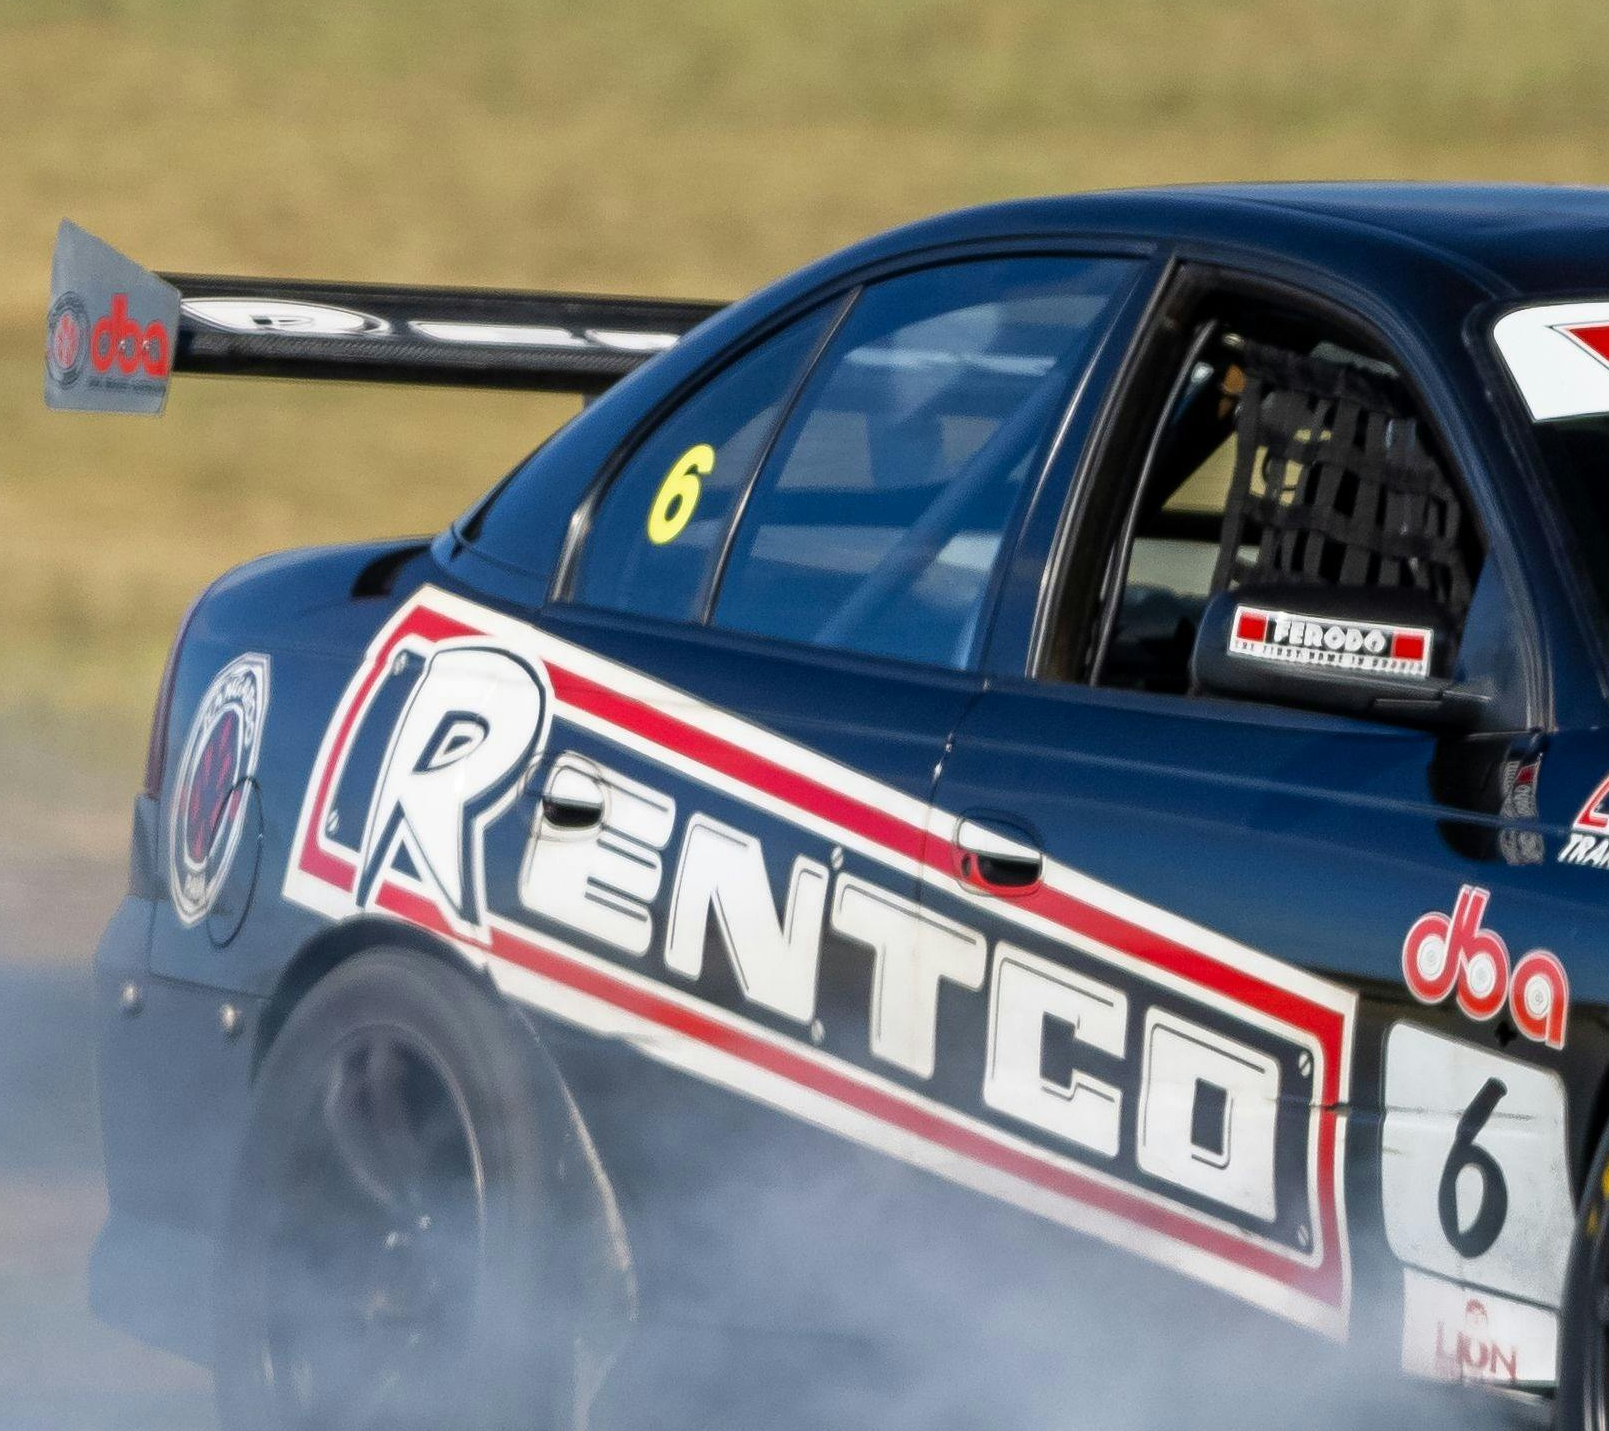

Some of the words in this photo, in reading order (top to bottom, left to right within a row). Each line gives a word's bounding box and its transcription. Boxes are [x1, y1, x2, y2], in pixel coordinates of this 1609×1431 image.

[90, 291, 170, 377] dba
[647, 442, 716, 546] 6
[1273, 618, 1387, 655] FERODO
[357, 636, 1281, 1225] RENTCO
[1401, 884, 1569, 1051] dba
[1438, 1076, 1509, 1259] 6
